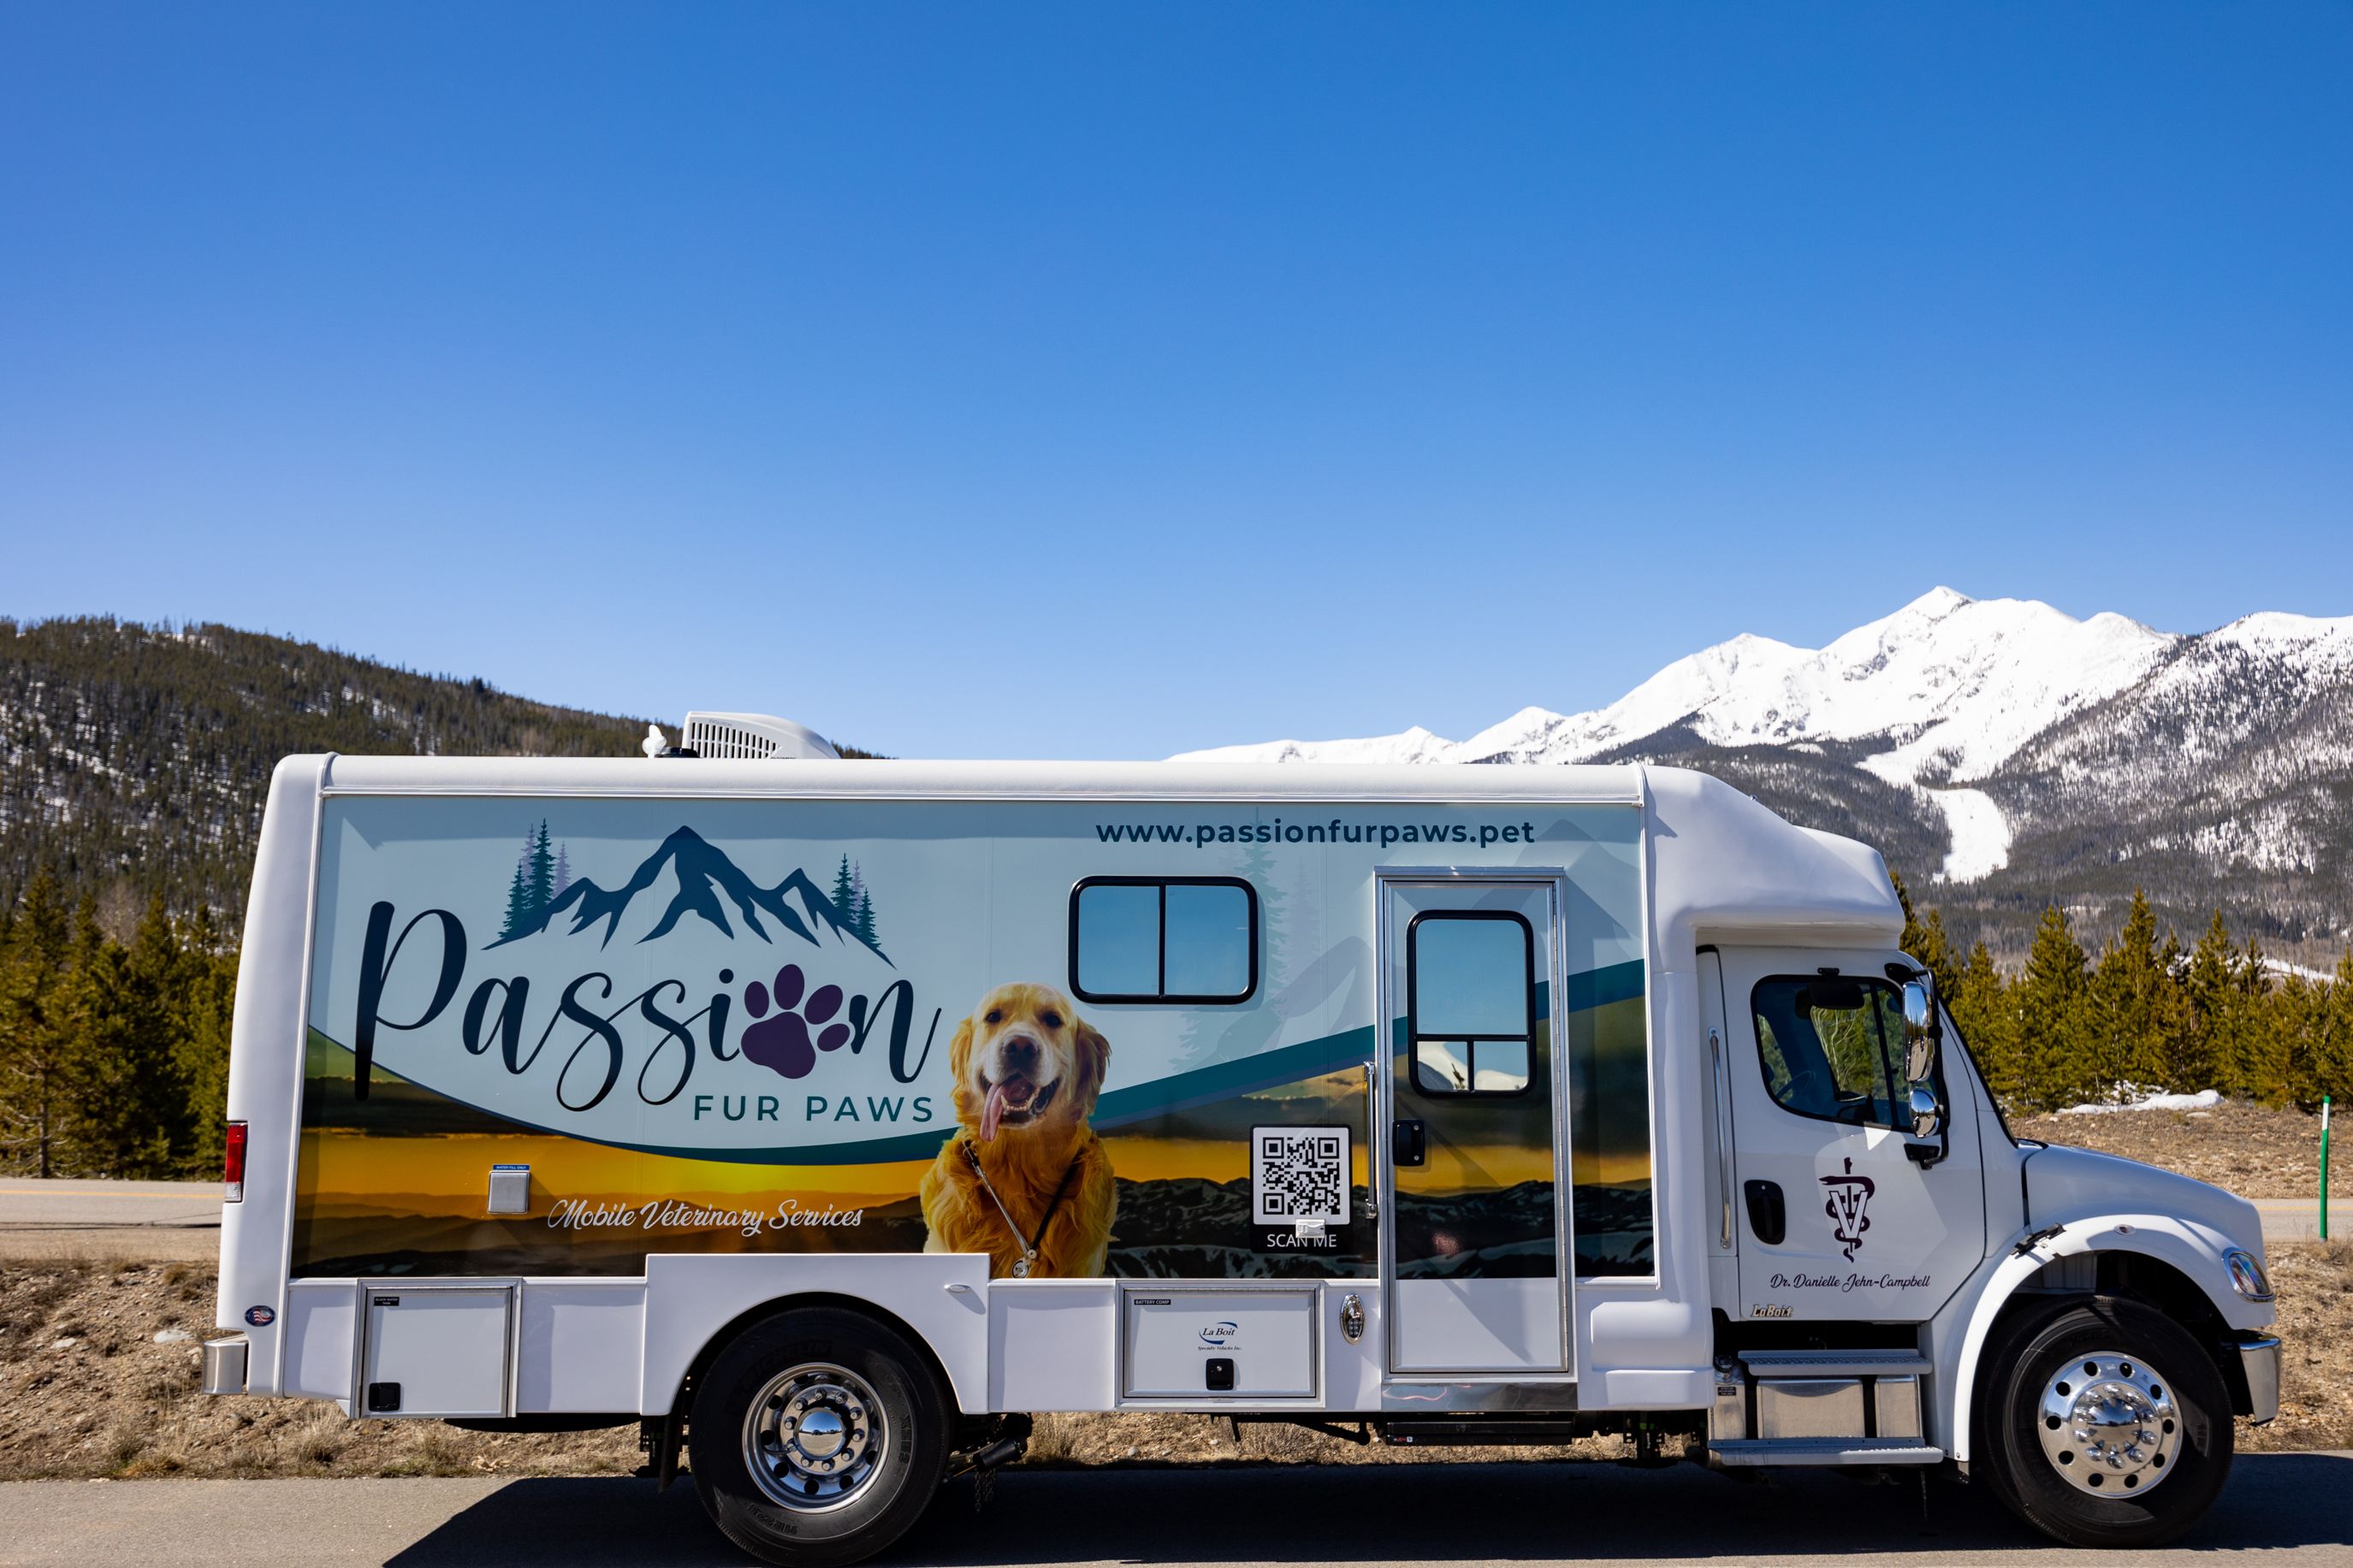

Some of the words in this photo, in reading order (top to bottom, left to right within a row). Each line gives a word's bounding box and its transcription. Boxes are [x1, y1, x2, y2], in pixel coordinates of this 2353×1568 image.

[1096, 818, 1535, 849] www.passionfurpaws.pet
[354, 901, 942, 1112] Passin
[694, 1095, 779, 1121] FUR
[806, 1096, 933, 1122] PAWS
[548, 1198, 637, 1230] Mobile
[639, 1198, 765, 1237] Veterinary
[769, 1198, 863, 1230] Services
[1266, 1234, 1307, 1247] SCAN
[1313, 1234, 1337, 1247] ME
[1770, 1273, 1791, 1288] Dr.
[1793, 1273, 1840, 1288] Danielle
[1751, 1304, 1794, 1318] LaBoit
[1202, 1328, 1214, 1336] La
[1215, 1328, 1236, 1336] Boit
